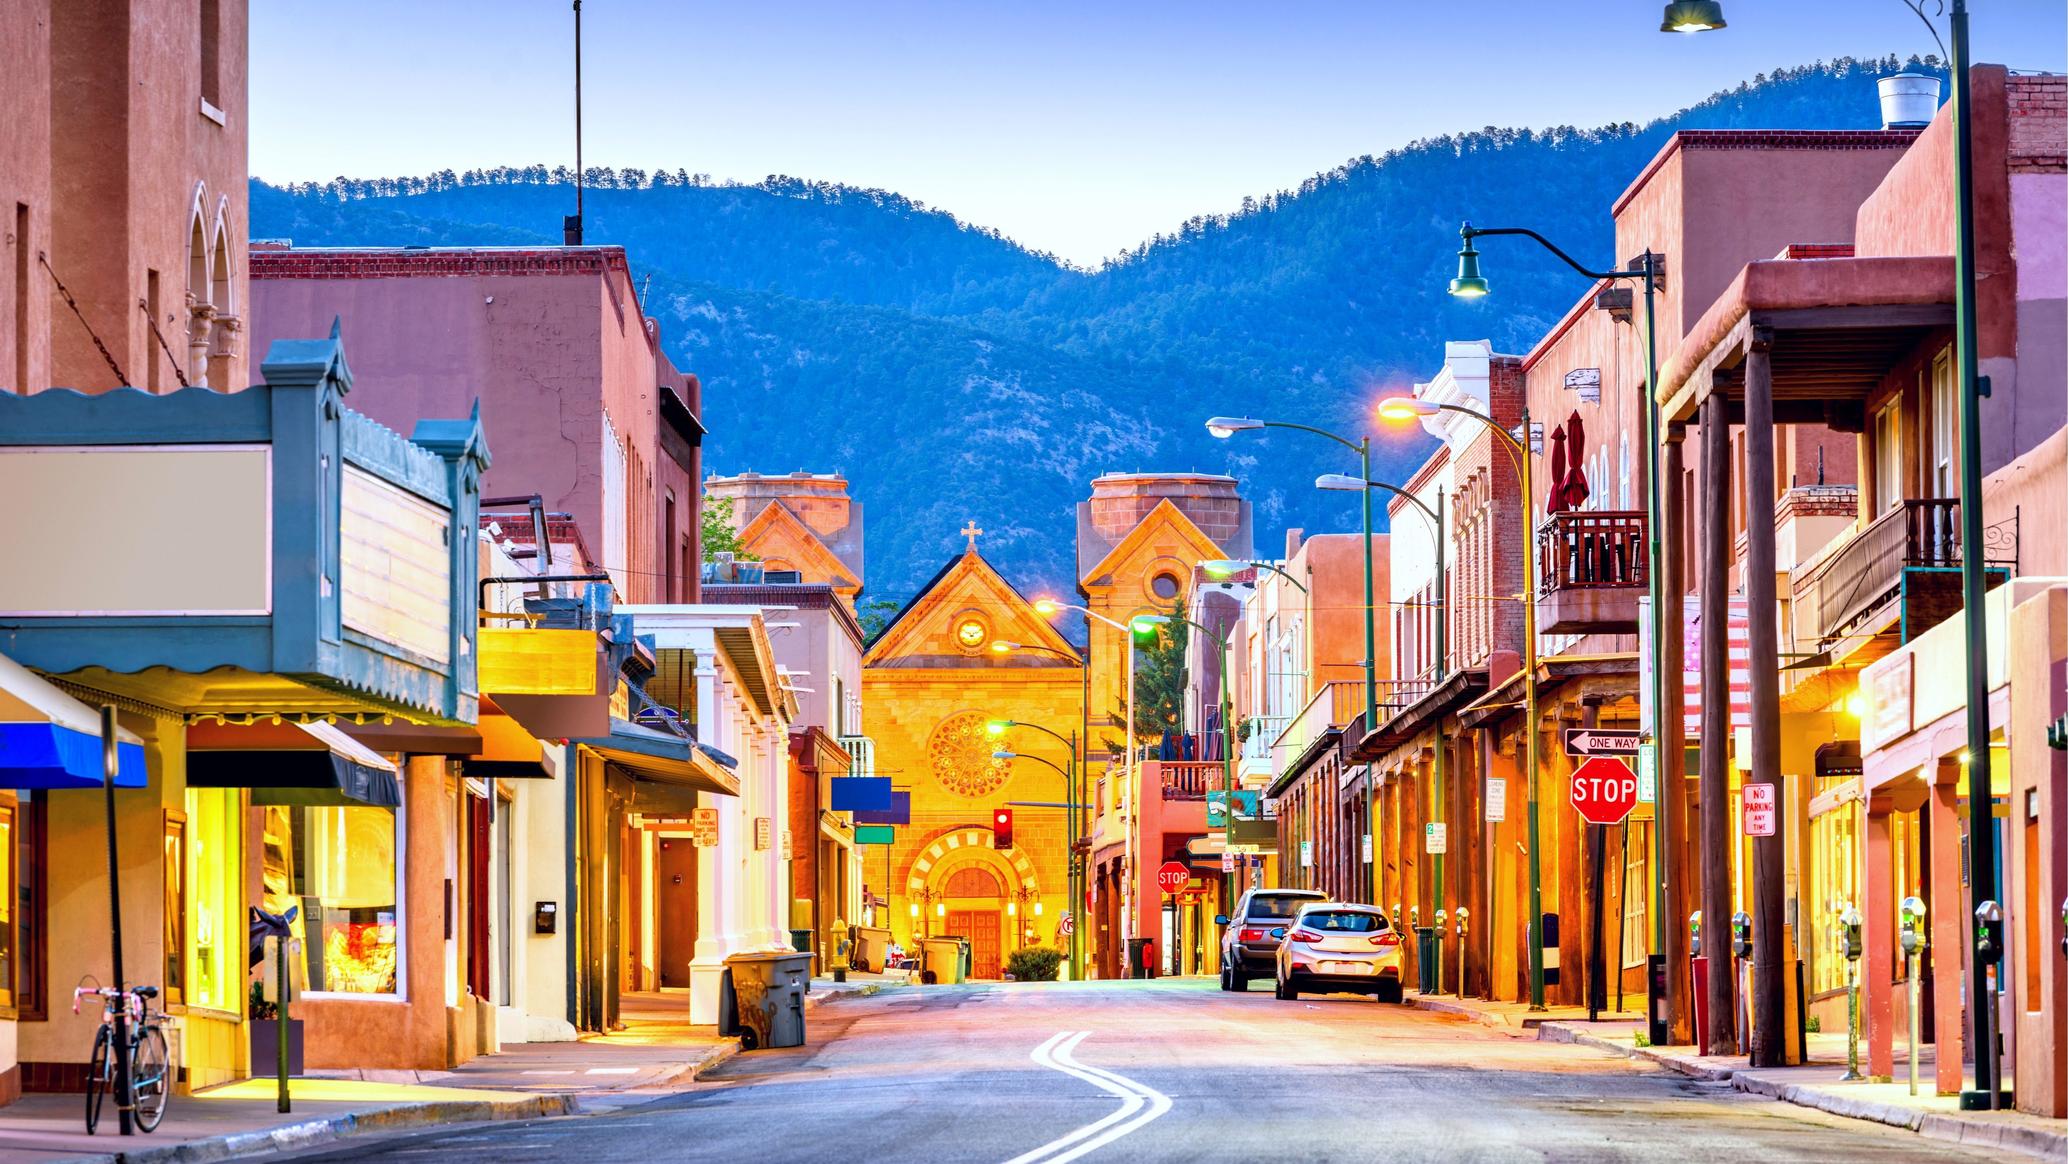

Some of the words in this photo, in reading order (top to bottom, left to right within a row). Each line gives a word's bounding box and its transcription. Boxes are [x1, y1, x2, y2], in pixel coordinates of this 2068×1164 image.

[1590, 738, 1610, 748] ONE
[1614, 738, 1636, 748] WAY
[1573, 777, 1635, 803] STOP
[1753, 790, 1765, 799] NO
[1745, 802, 1773, 811] PARKING
[701, 812, 710, 820] NO
[1428, 824, 1433, 833] 2
[1159, 872, 1188, 884] STOP
